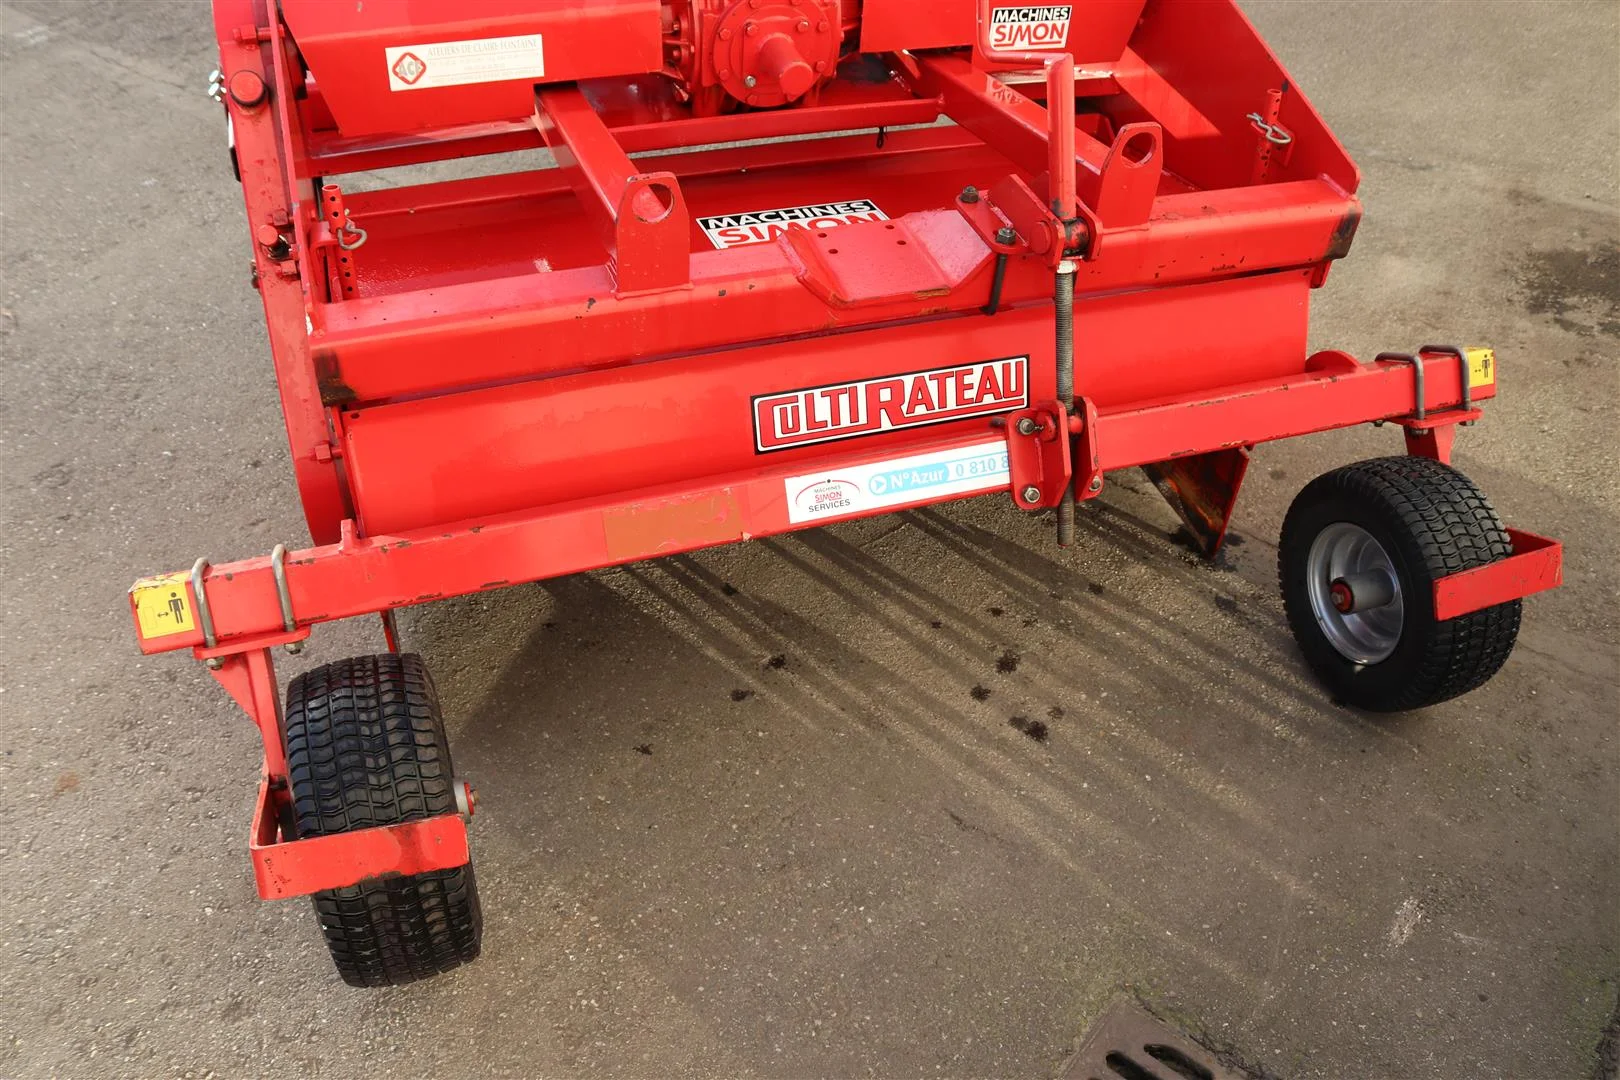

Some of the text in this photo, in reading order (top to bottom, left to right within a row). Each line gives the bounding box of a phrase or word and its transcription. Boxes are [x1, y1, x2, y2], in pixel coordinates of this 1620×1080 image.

[995, 8, 1069, 23] MACHINES
[994, 23, 1065, 47] SIMON
[428, 46, 461, 57] ATELIERS
[461, 44, 473, 54] DE
[473, 42, 499, 53] CLAIRE
[707, 201, 871, 229] MACHINES
[758, 360, 1024, 447] CULTIRATEAU
[955, 463, 964, 477] 0
[969, 457, 996, 474] 810
[814, 484, 841, 494] MACHINES
[815, 491, 842, 503] SIMON
[808, 498, 851, 512] SERVICES
